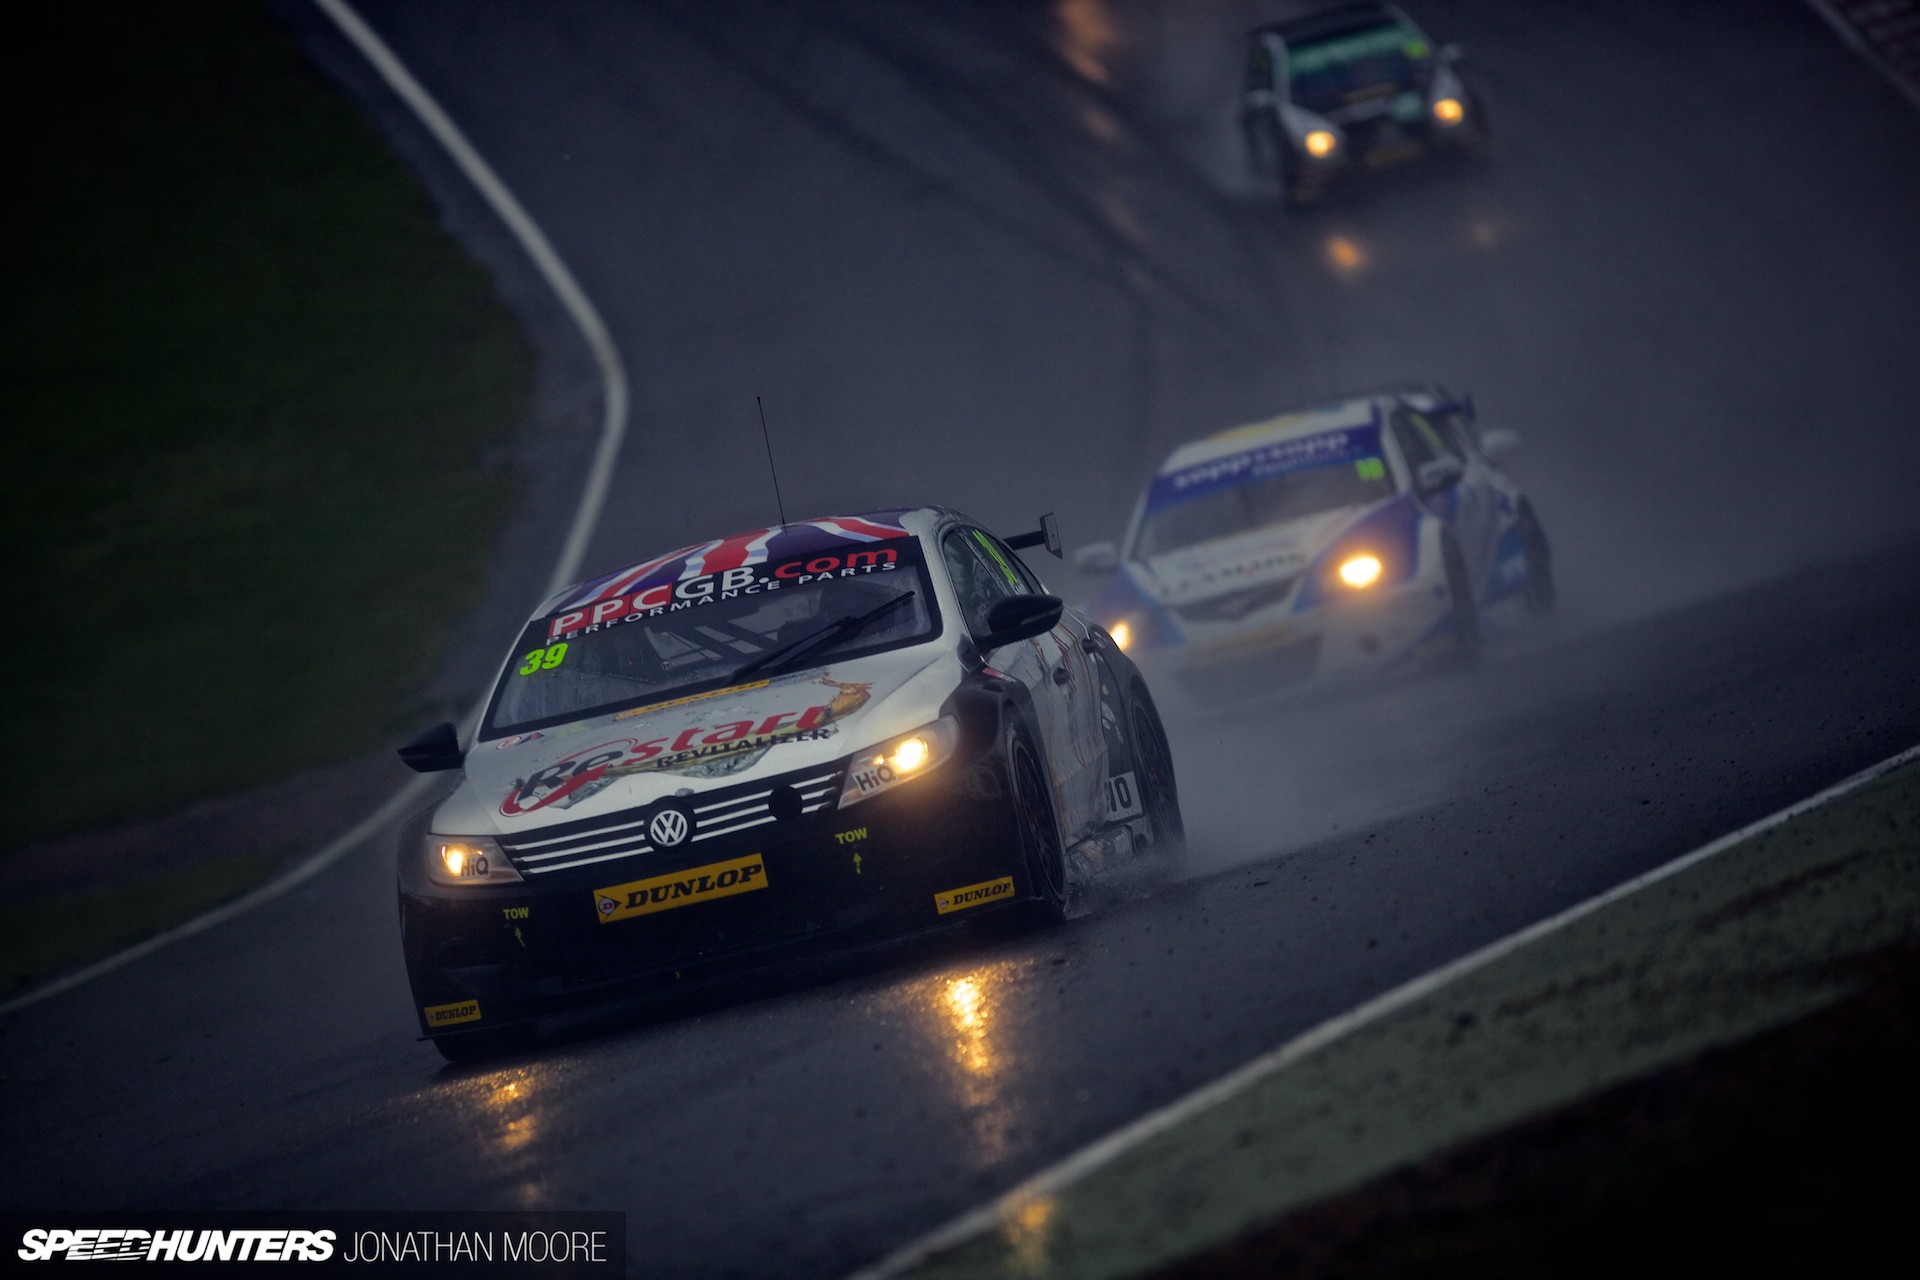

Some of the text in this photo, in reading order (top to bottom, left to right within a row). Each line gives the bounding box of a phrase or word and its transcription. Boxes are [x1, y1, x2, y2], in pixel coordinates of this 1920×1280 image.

[545, 561, 897, 647] PERFORMANCE PARTS
[548, 547, 898, 639] PPCGB.com
[519, 643, 569, 677] 39
[656, 728, 831, 768] REVITALIZER
[855, 765, 897, 792] HiQ
[835, 826, 868, 846] TOW
[461, 856, 489, 878] HiQ
[626, 863, 763, 909] DUNLOP
[952, 882, 1012, 906] DUNLOP
[502, 906, 530, 921] TOW
[435, 1004, 477, 1022] DUNLOP
